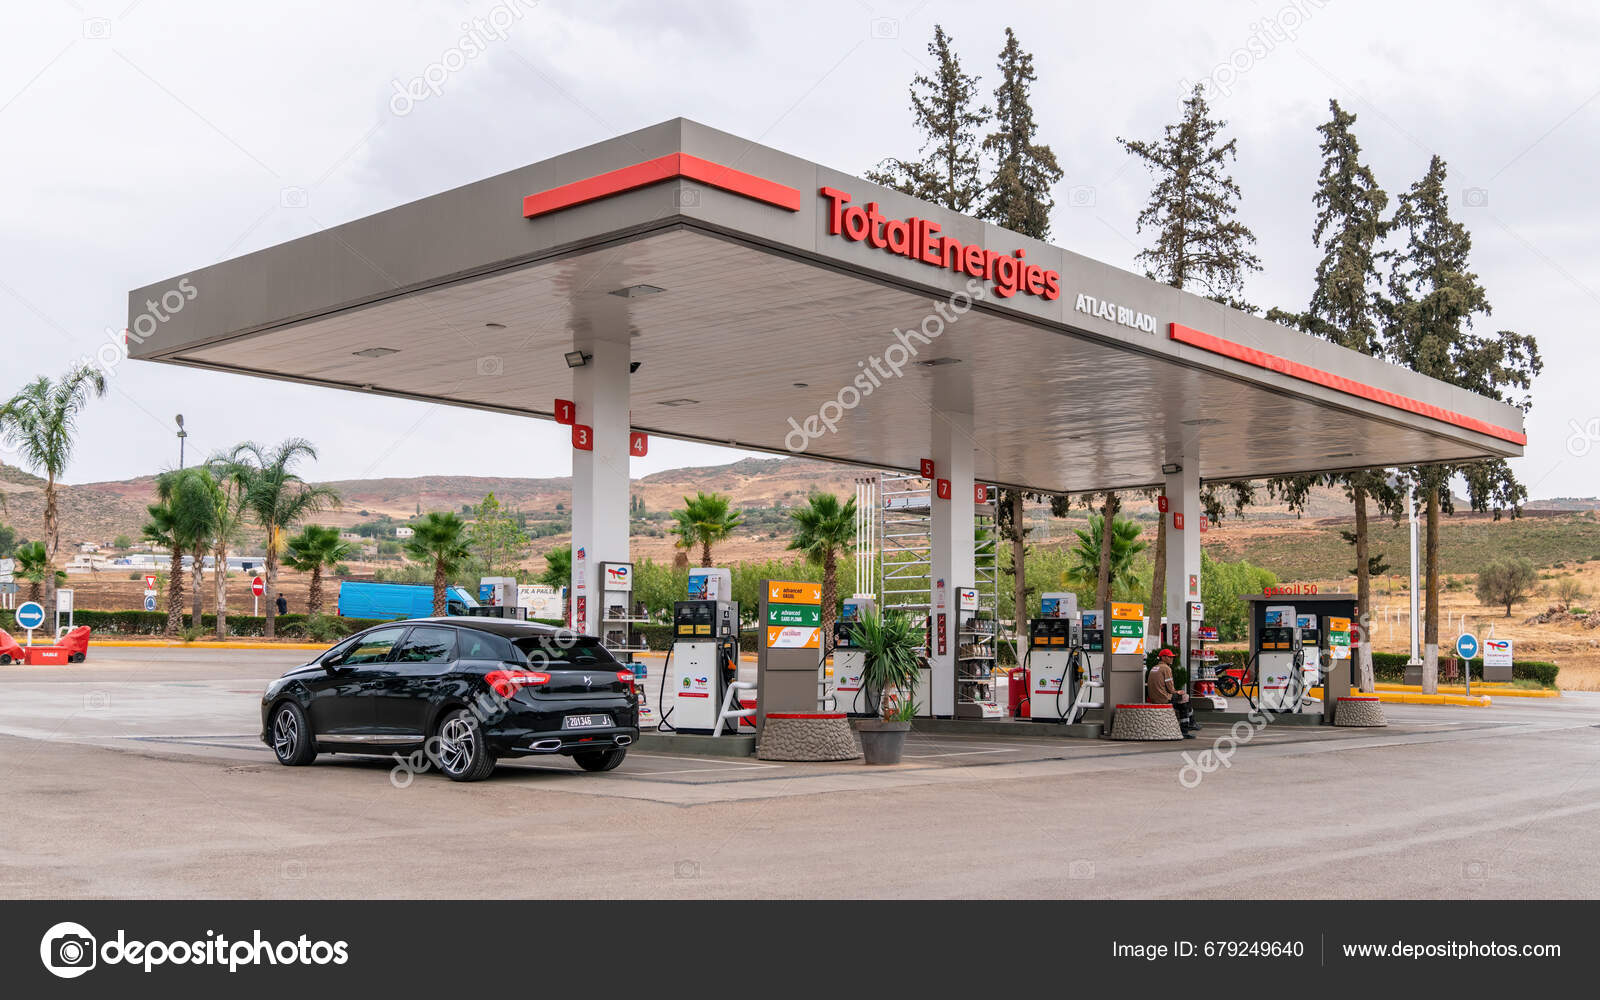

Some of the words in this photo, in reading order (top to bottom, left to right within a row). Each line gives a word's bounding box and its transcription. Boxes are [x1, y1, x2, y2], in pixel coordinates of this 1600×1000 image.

[821, 186, 1060, 301] TotalEnergies
[1075, 293, 1116, 321] ATLAS
[1117, 305, 1157, 334] BILADI
[562, 405, 569, 420] 1
[579, 429, 587, 445] 3
[634, 437, 643, 452] 4
[925, 463, 931, 475] 5
[942, 482, 948, 496] 7
[977, 488, 983, 500] 8
[1264, 584, 1300, 598] gasoil
[1303, 584, 1318, 595] 50
[570, 717, 592, 727] 201346
